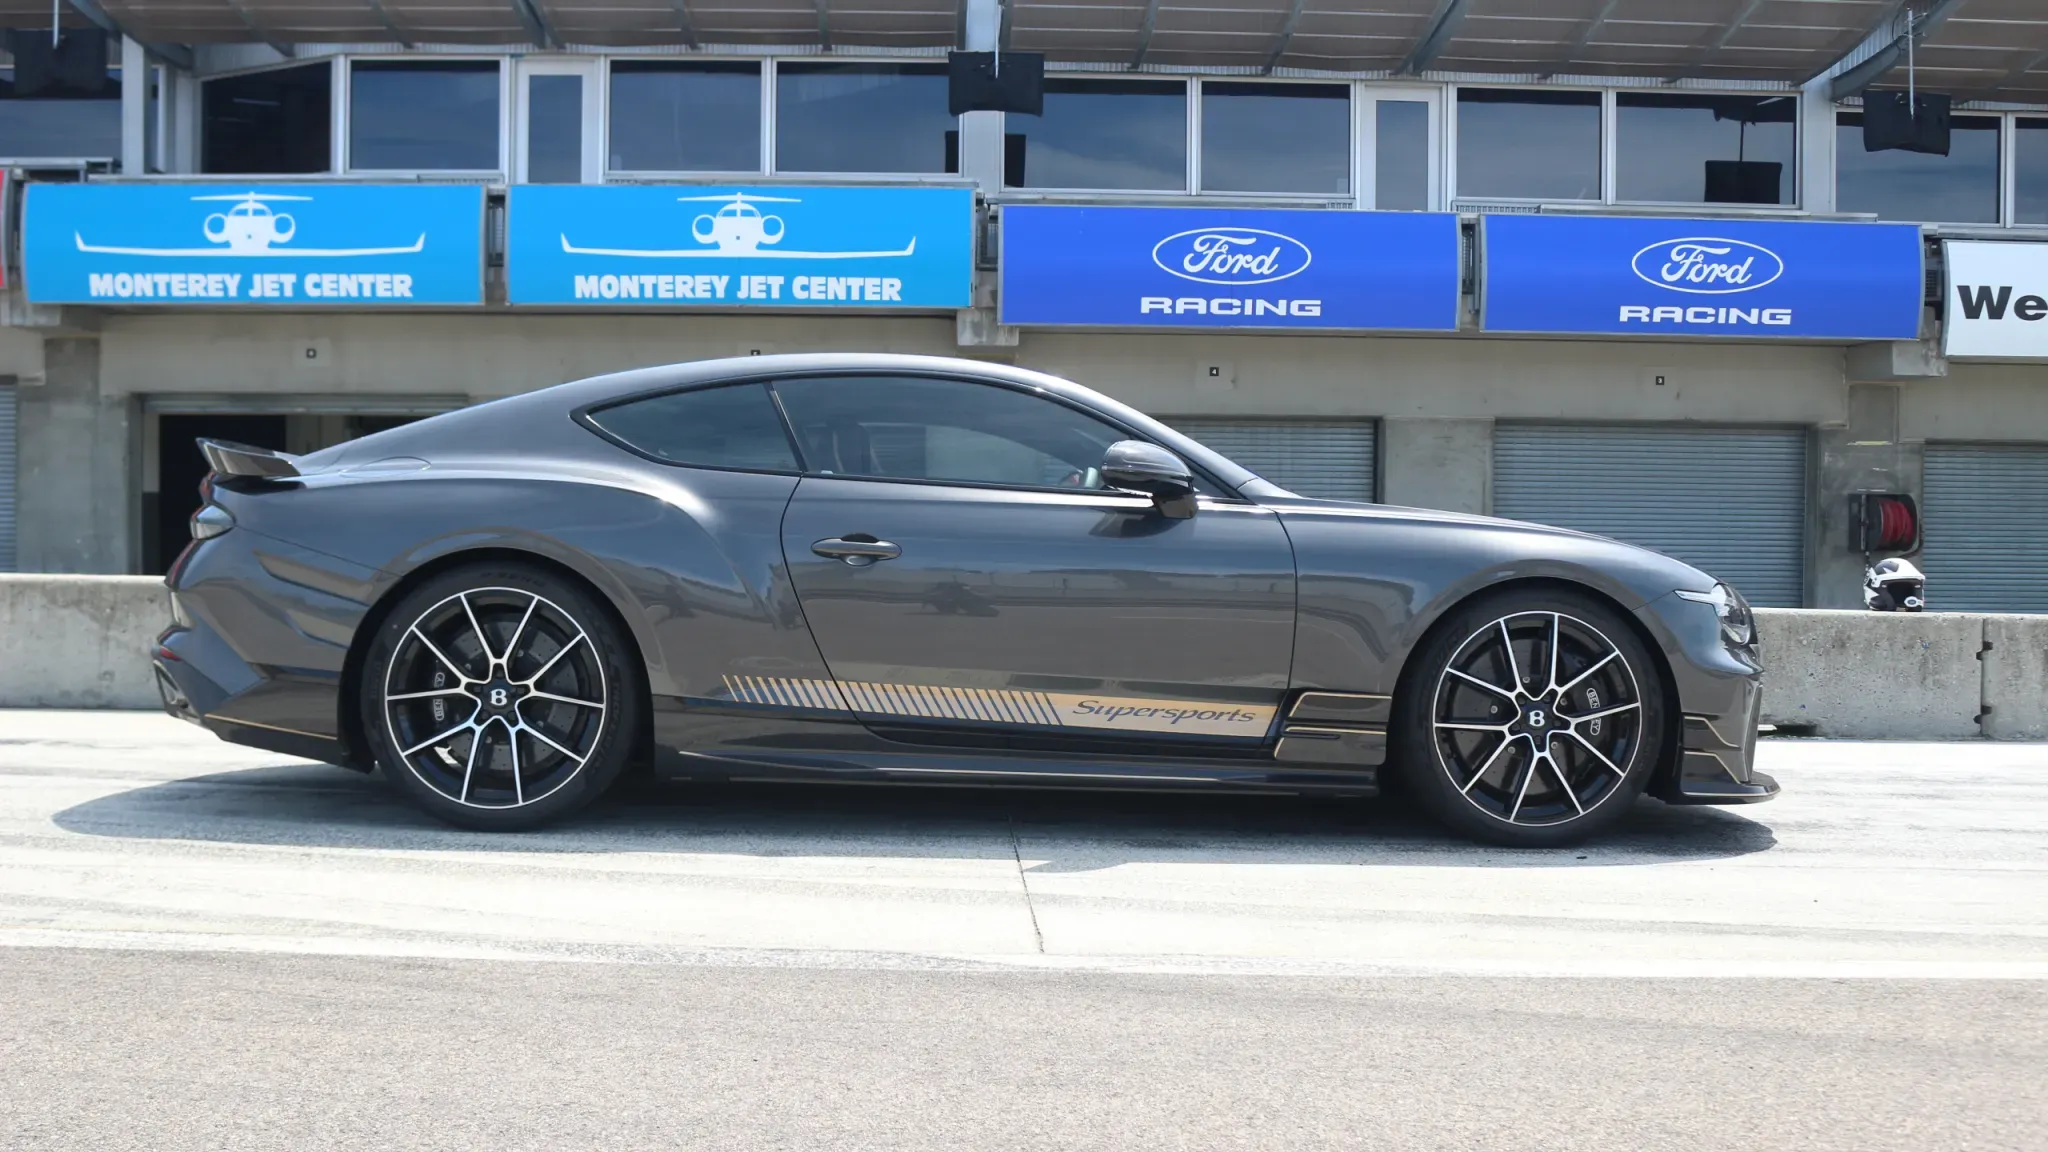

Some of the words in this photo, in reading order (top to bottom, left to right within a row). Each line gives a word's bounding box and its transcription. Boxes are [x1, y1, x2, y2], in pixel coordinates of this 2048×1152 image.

[1183, 234, 1281, 275] Ford
[1661, 244, 1753, 286] Ford
[89, 273, 241, 297] MONTEREY
[249, 274, 297, 298] JET
[304, 274, 413, 298] CENTER
[574, 274, 730, 299] MONTEREY
[737, 275, 785, 300] JET
[792, 276, 902, 301] CENTER
[1140, 296, 1322, 317] RACING
[1619, 305, 1792, 326] RACING
[1957, 285, 2048, 321] We
[490, 688, 508, 706] B
[1072, 699, 1257, 725] Supersports
[1529, 710, 1545, 727] B
